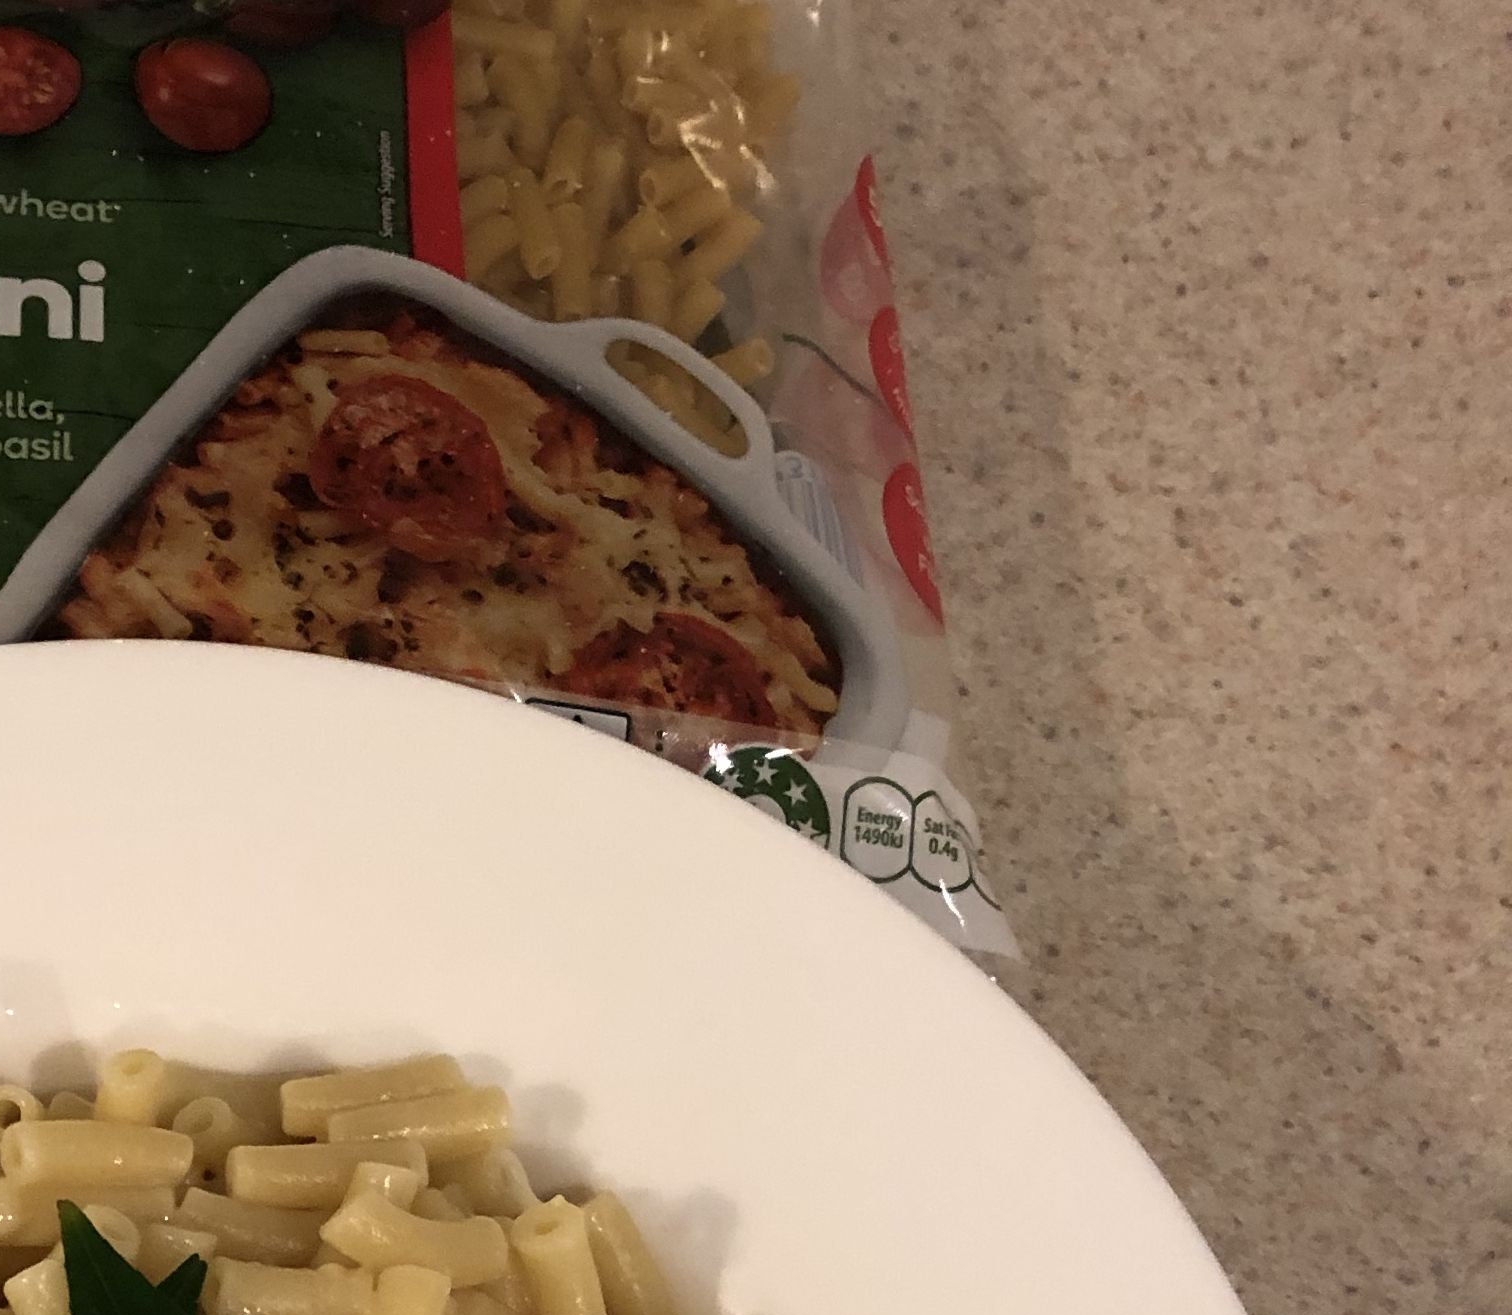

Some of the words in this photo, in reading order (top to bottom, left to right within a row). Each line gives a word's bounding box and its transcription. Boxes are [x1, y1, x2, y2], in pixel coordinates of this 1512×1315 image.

[857, 806, 904, 831] Energy
[923, 817, 944, 836] Sat
[854, 825, 904, 849] 1490kJ
[928, 837, 959, 862] 0.4g
